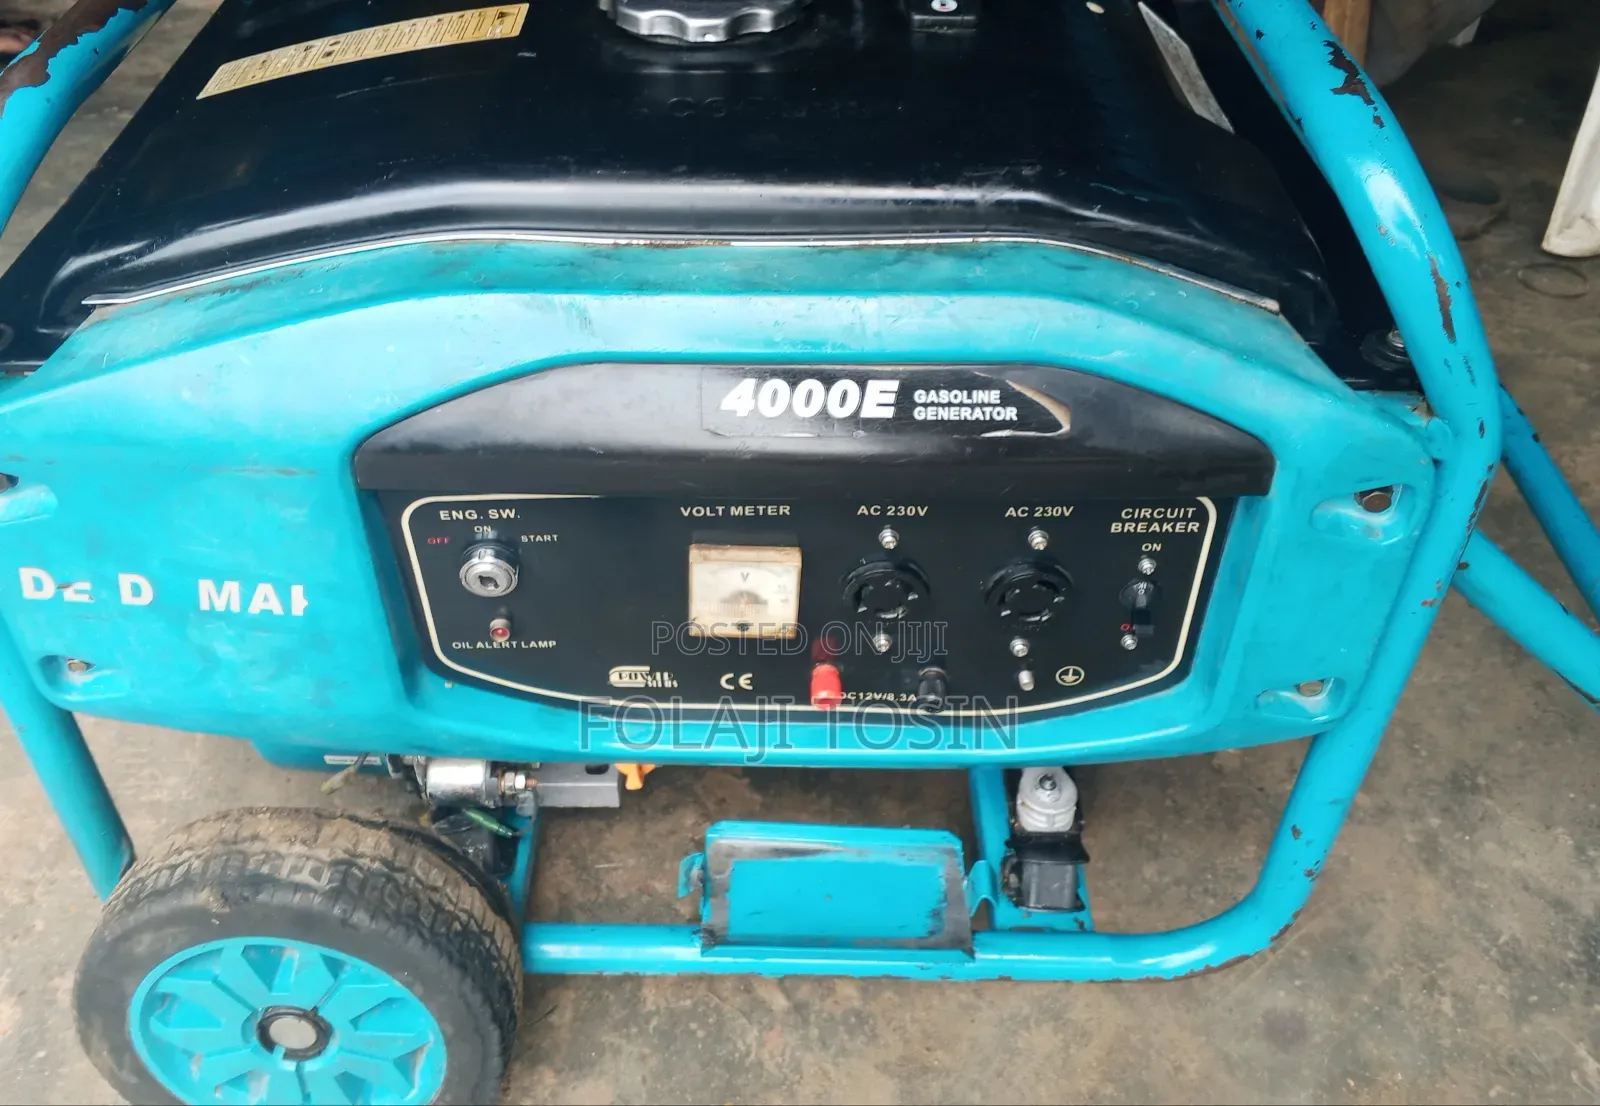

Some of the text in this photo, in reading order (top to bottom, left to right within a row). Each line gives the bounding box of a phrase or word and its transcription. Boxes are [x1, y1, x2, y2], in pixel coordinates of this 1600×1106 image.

[718, 378, 900, 419] 4000E
[913, 389, 1001, 404] GASOLINE
[913, 406, 1018, 421] GENERATOR
[439, 508, 521, 520] ENG. SW.
[680, 505, 791, 517] VOLT METER
[857, 505, 929, 517] AC 230V
[1005, 506, 1074, 517] AC 230V
[1121, 507, 1197, 519] CIRCUIT
[474, 525, 493, 533] ON
[1110, 521, 1200, 533] BREAKER
[521, 534, 559, 543] START
[1141, 543, 1162, 552] ON
[741, 572, 750, 582] V
[452, 640, 557, 649] OIL ALERT LAMP
